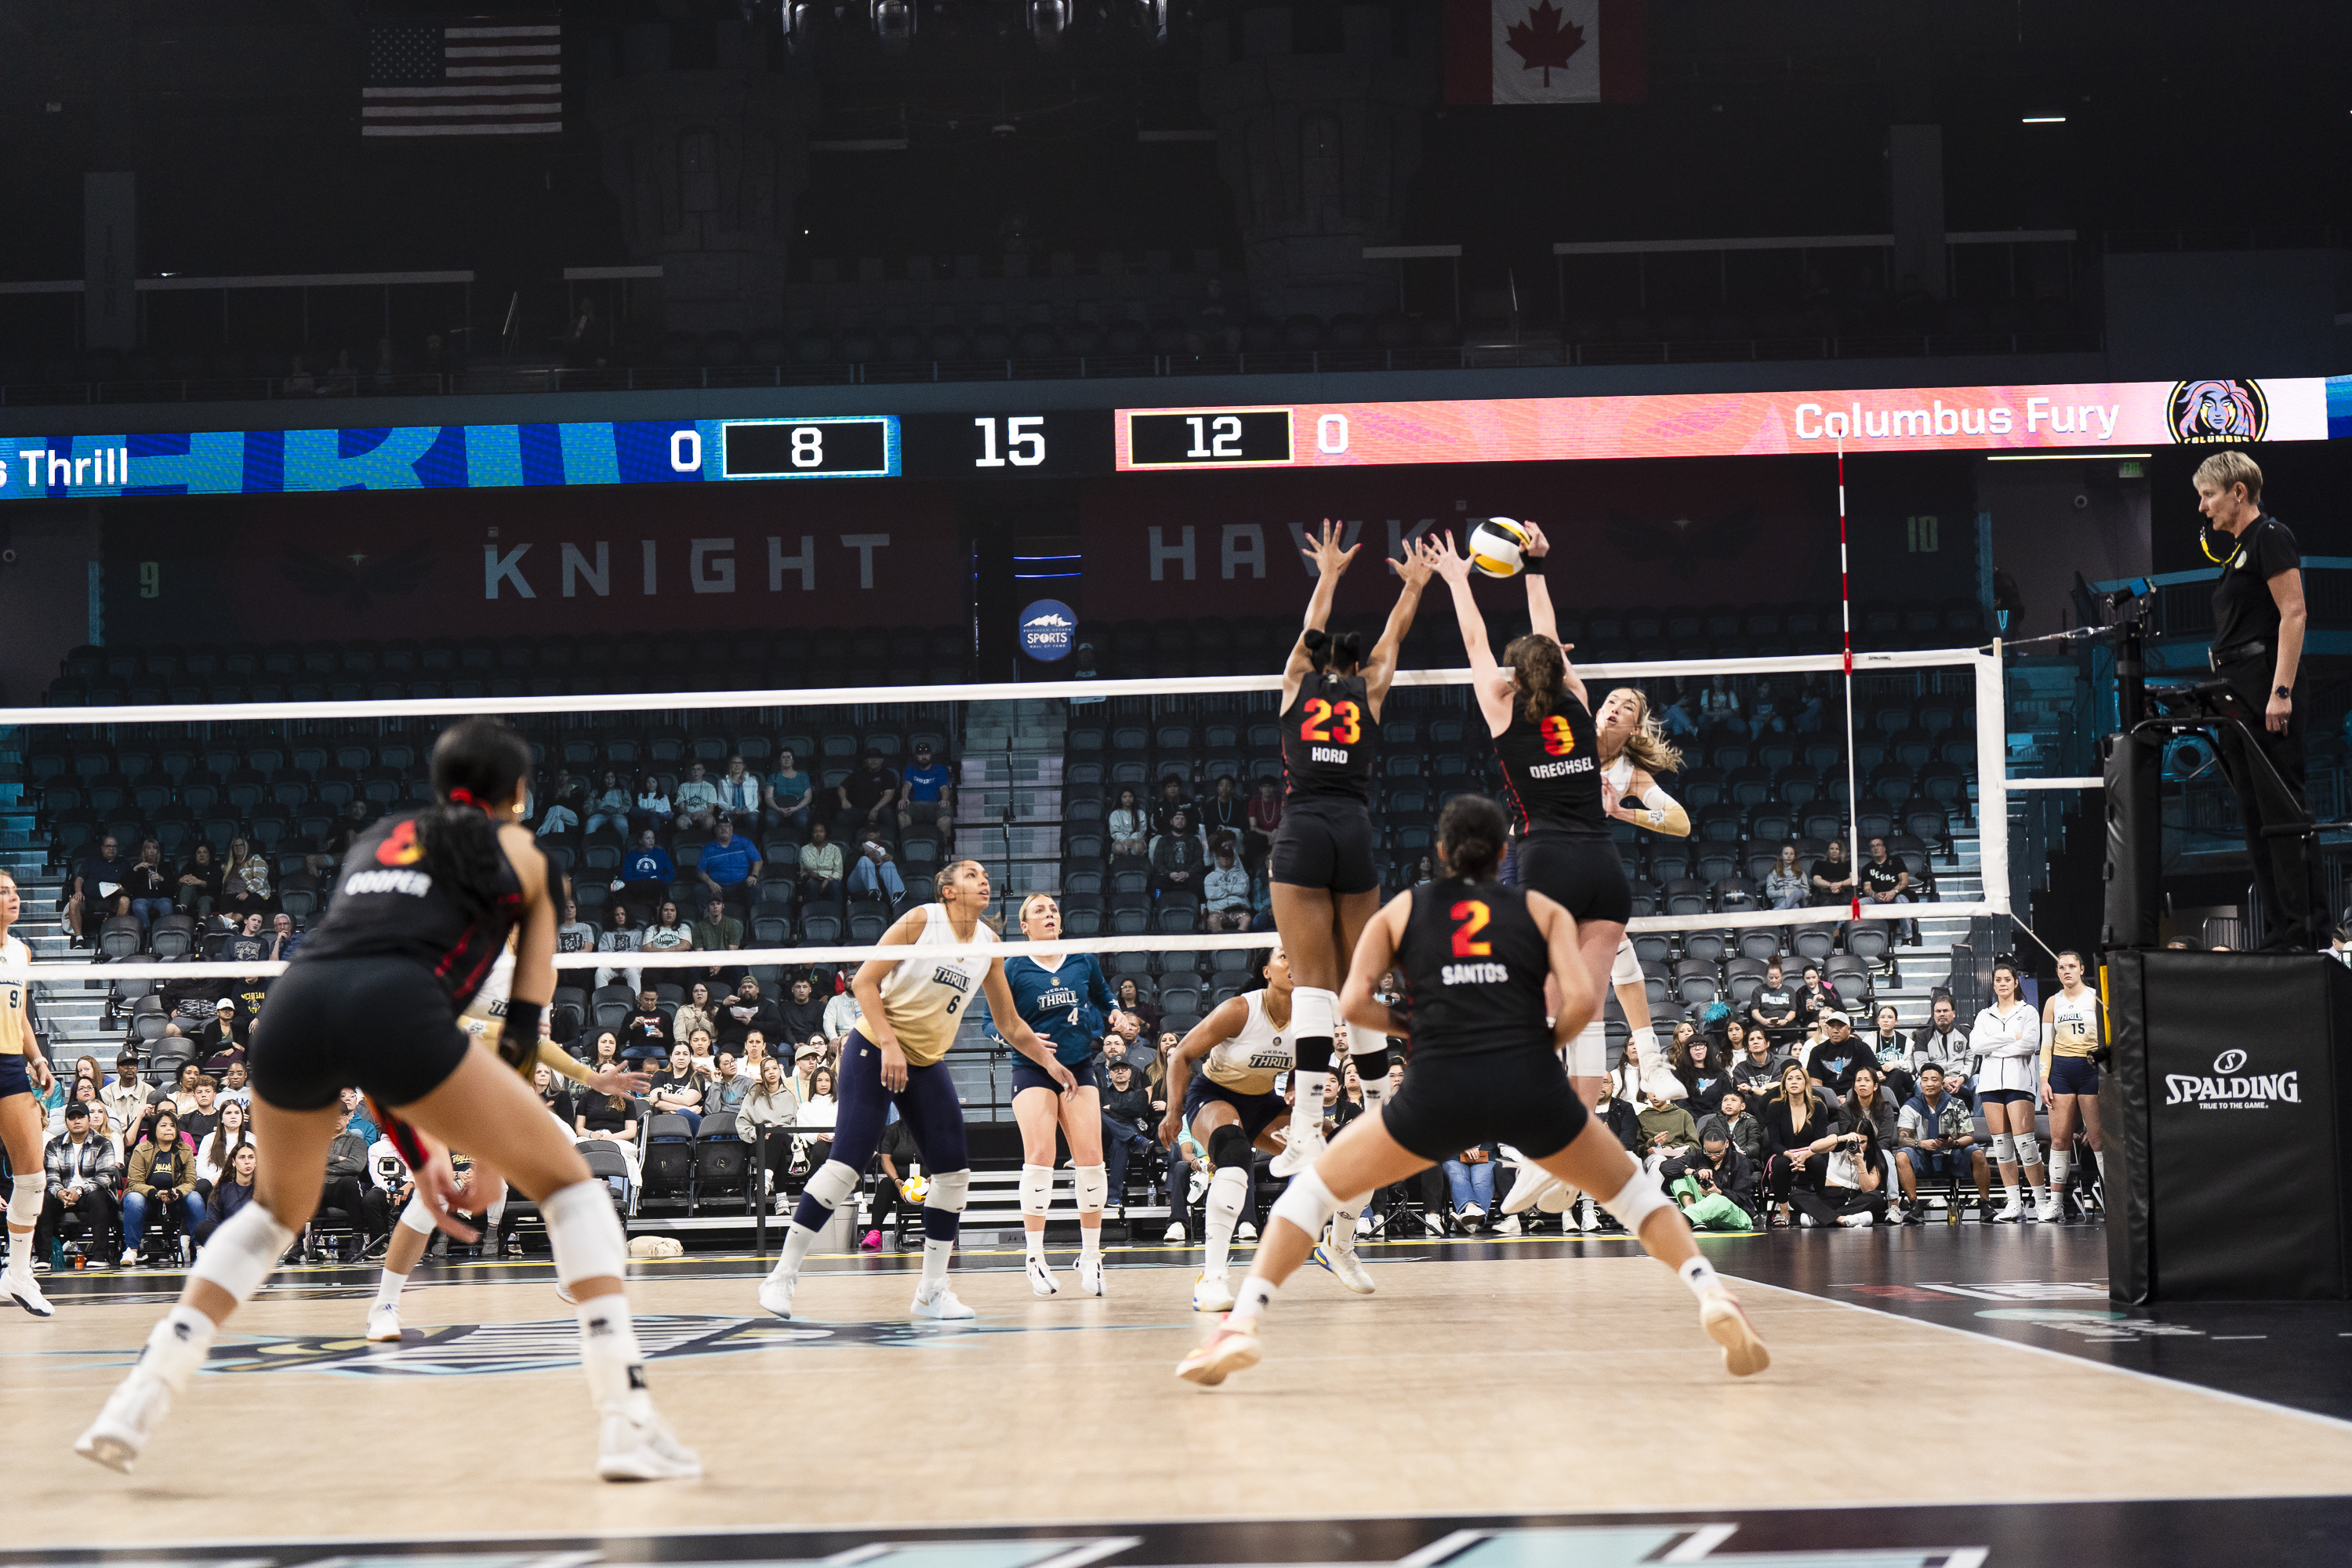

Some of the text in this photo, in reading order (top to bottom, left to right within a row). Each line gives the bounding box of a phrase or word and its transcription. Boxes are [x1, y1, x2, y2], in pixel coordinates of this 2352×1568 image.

[1186, 416, 1242, 457] 12
[1317, 414, 1348, 455] 0
[1795, 397, 2120, 441] Columbus Fury
[670, 430, 701, 472] 0
[791, 426, 823, 467] 8
[975, 416, 1046, 467] 15
[20, 448, 128, 487] Thrill
[1148, 518, 1494, 581] HAWK
[1907, 515, 1939, 552] 10
[140, 561, 160, 598] 9
[483, 533, 890, 600] KNIGHT
[1027, 632, 1068, 644] SPORTS
[1301, 697, 1361, 745] 23
[1312, 746, 1348, 764] HORD
[1529, 756, 1595, 779] DRECHSEL
[1450, 899, 1493, 958] 2
[934, 967, 970, 993] THRILL
[1441, 962, 1509, 985] SANTOS
[946, 995, 960, 1014] 6
[1039, 992, 1078, 1009] THRILL
[1068, 1007, 1079, 1025] 4
[2071, 1023, 2085, 1035] 15
[1250, 1055, 1292, 1069] THRILL
[2165, 1071, 2299, 1105] SPALDING
